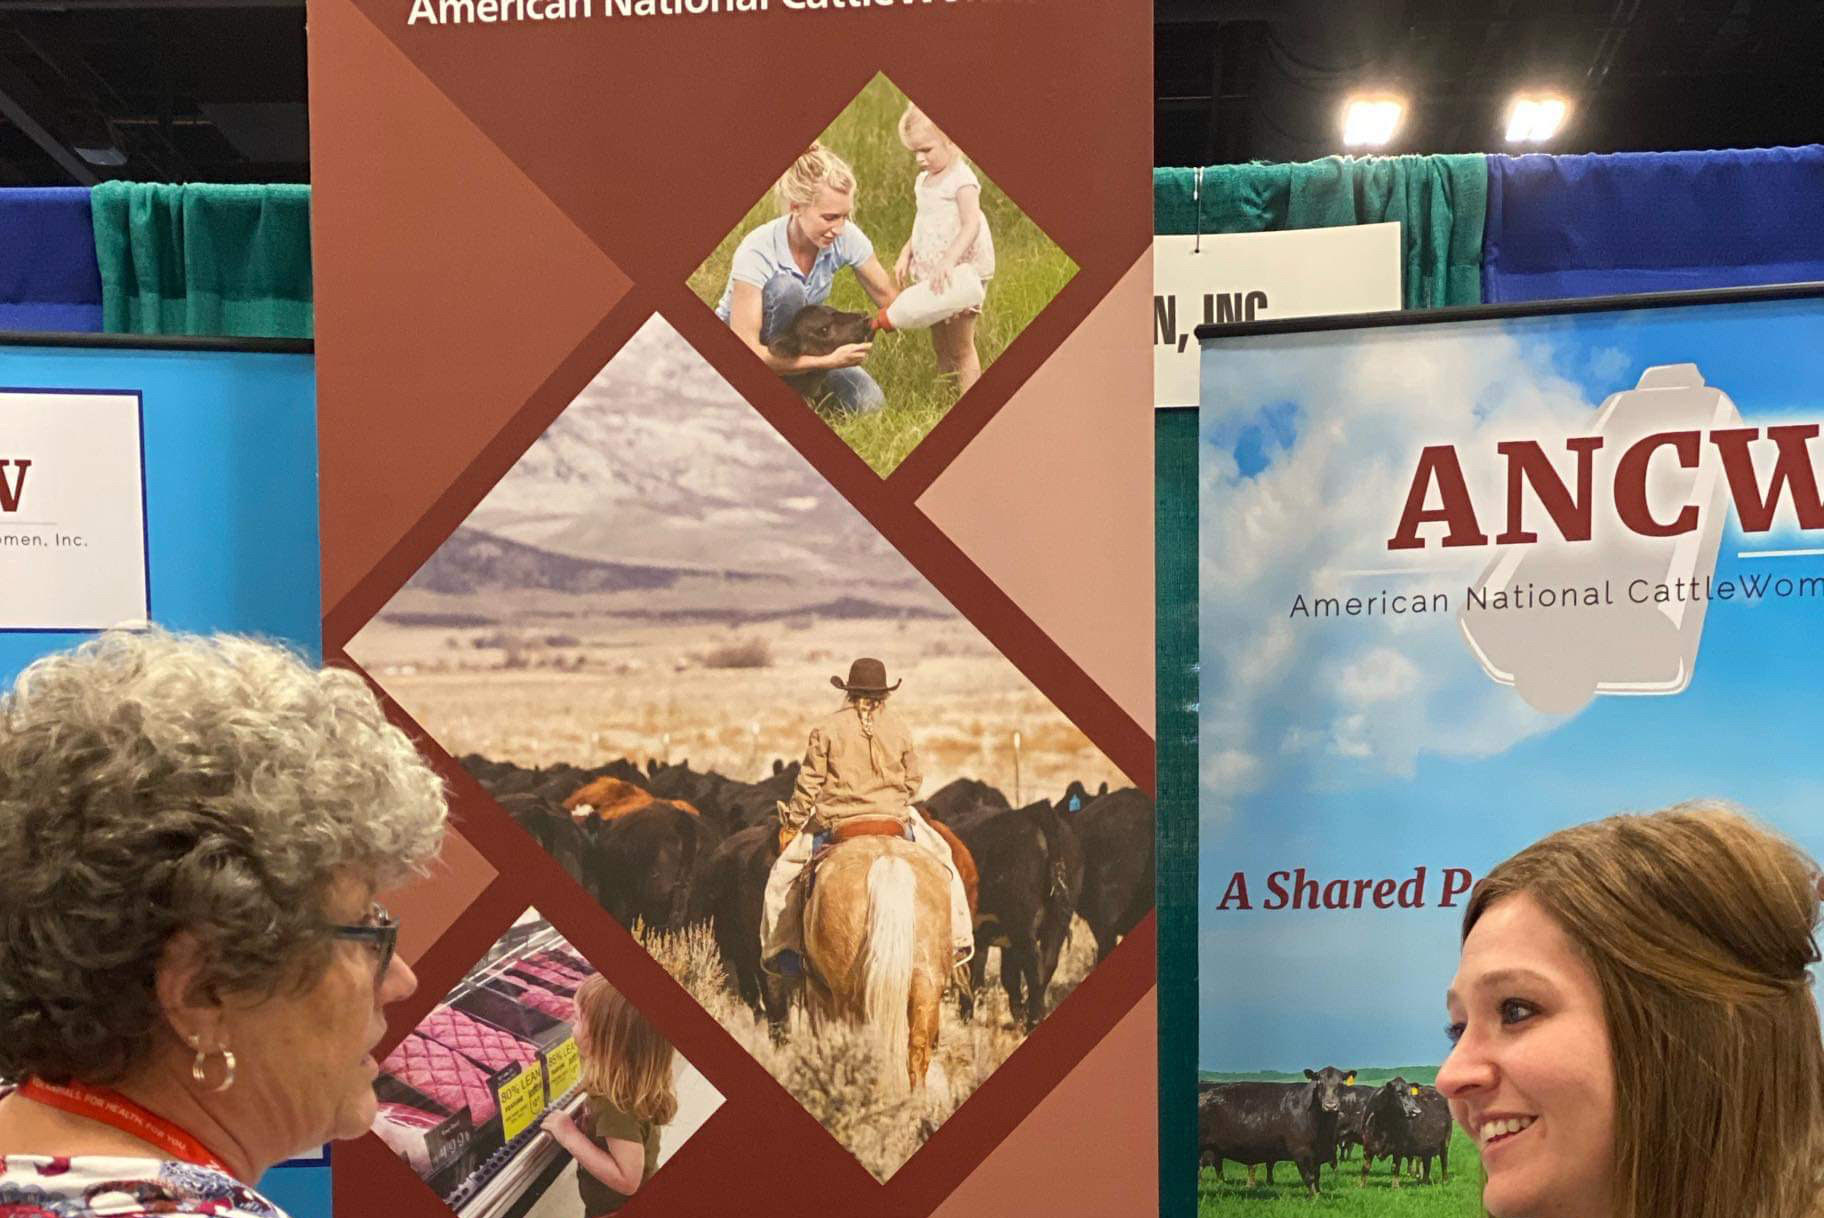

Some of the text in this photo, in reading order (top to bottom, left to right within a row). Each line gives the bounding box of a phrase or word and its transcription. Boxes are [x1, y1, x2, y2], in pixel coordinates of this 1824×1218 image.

[55, 532, 88, 547] Inc.
[1289, 588, 1449, 619] American
[1465, 578, 1614, 611] National
[1216, 866, 1487, 911] A Shared P
